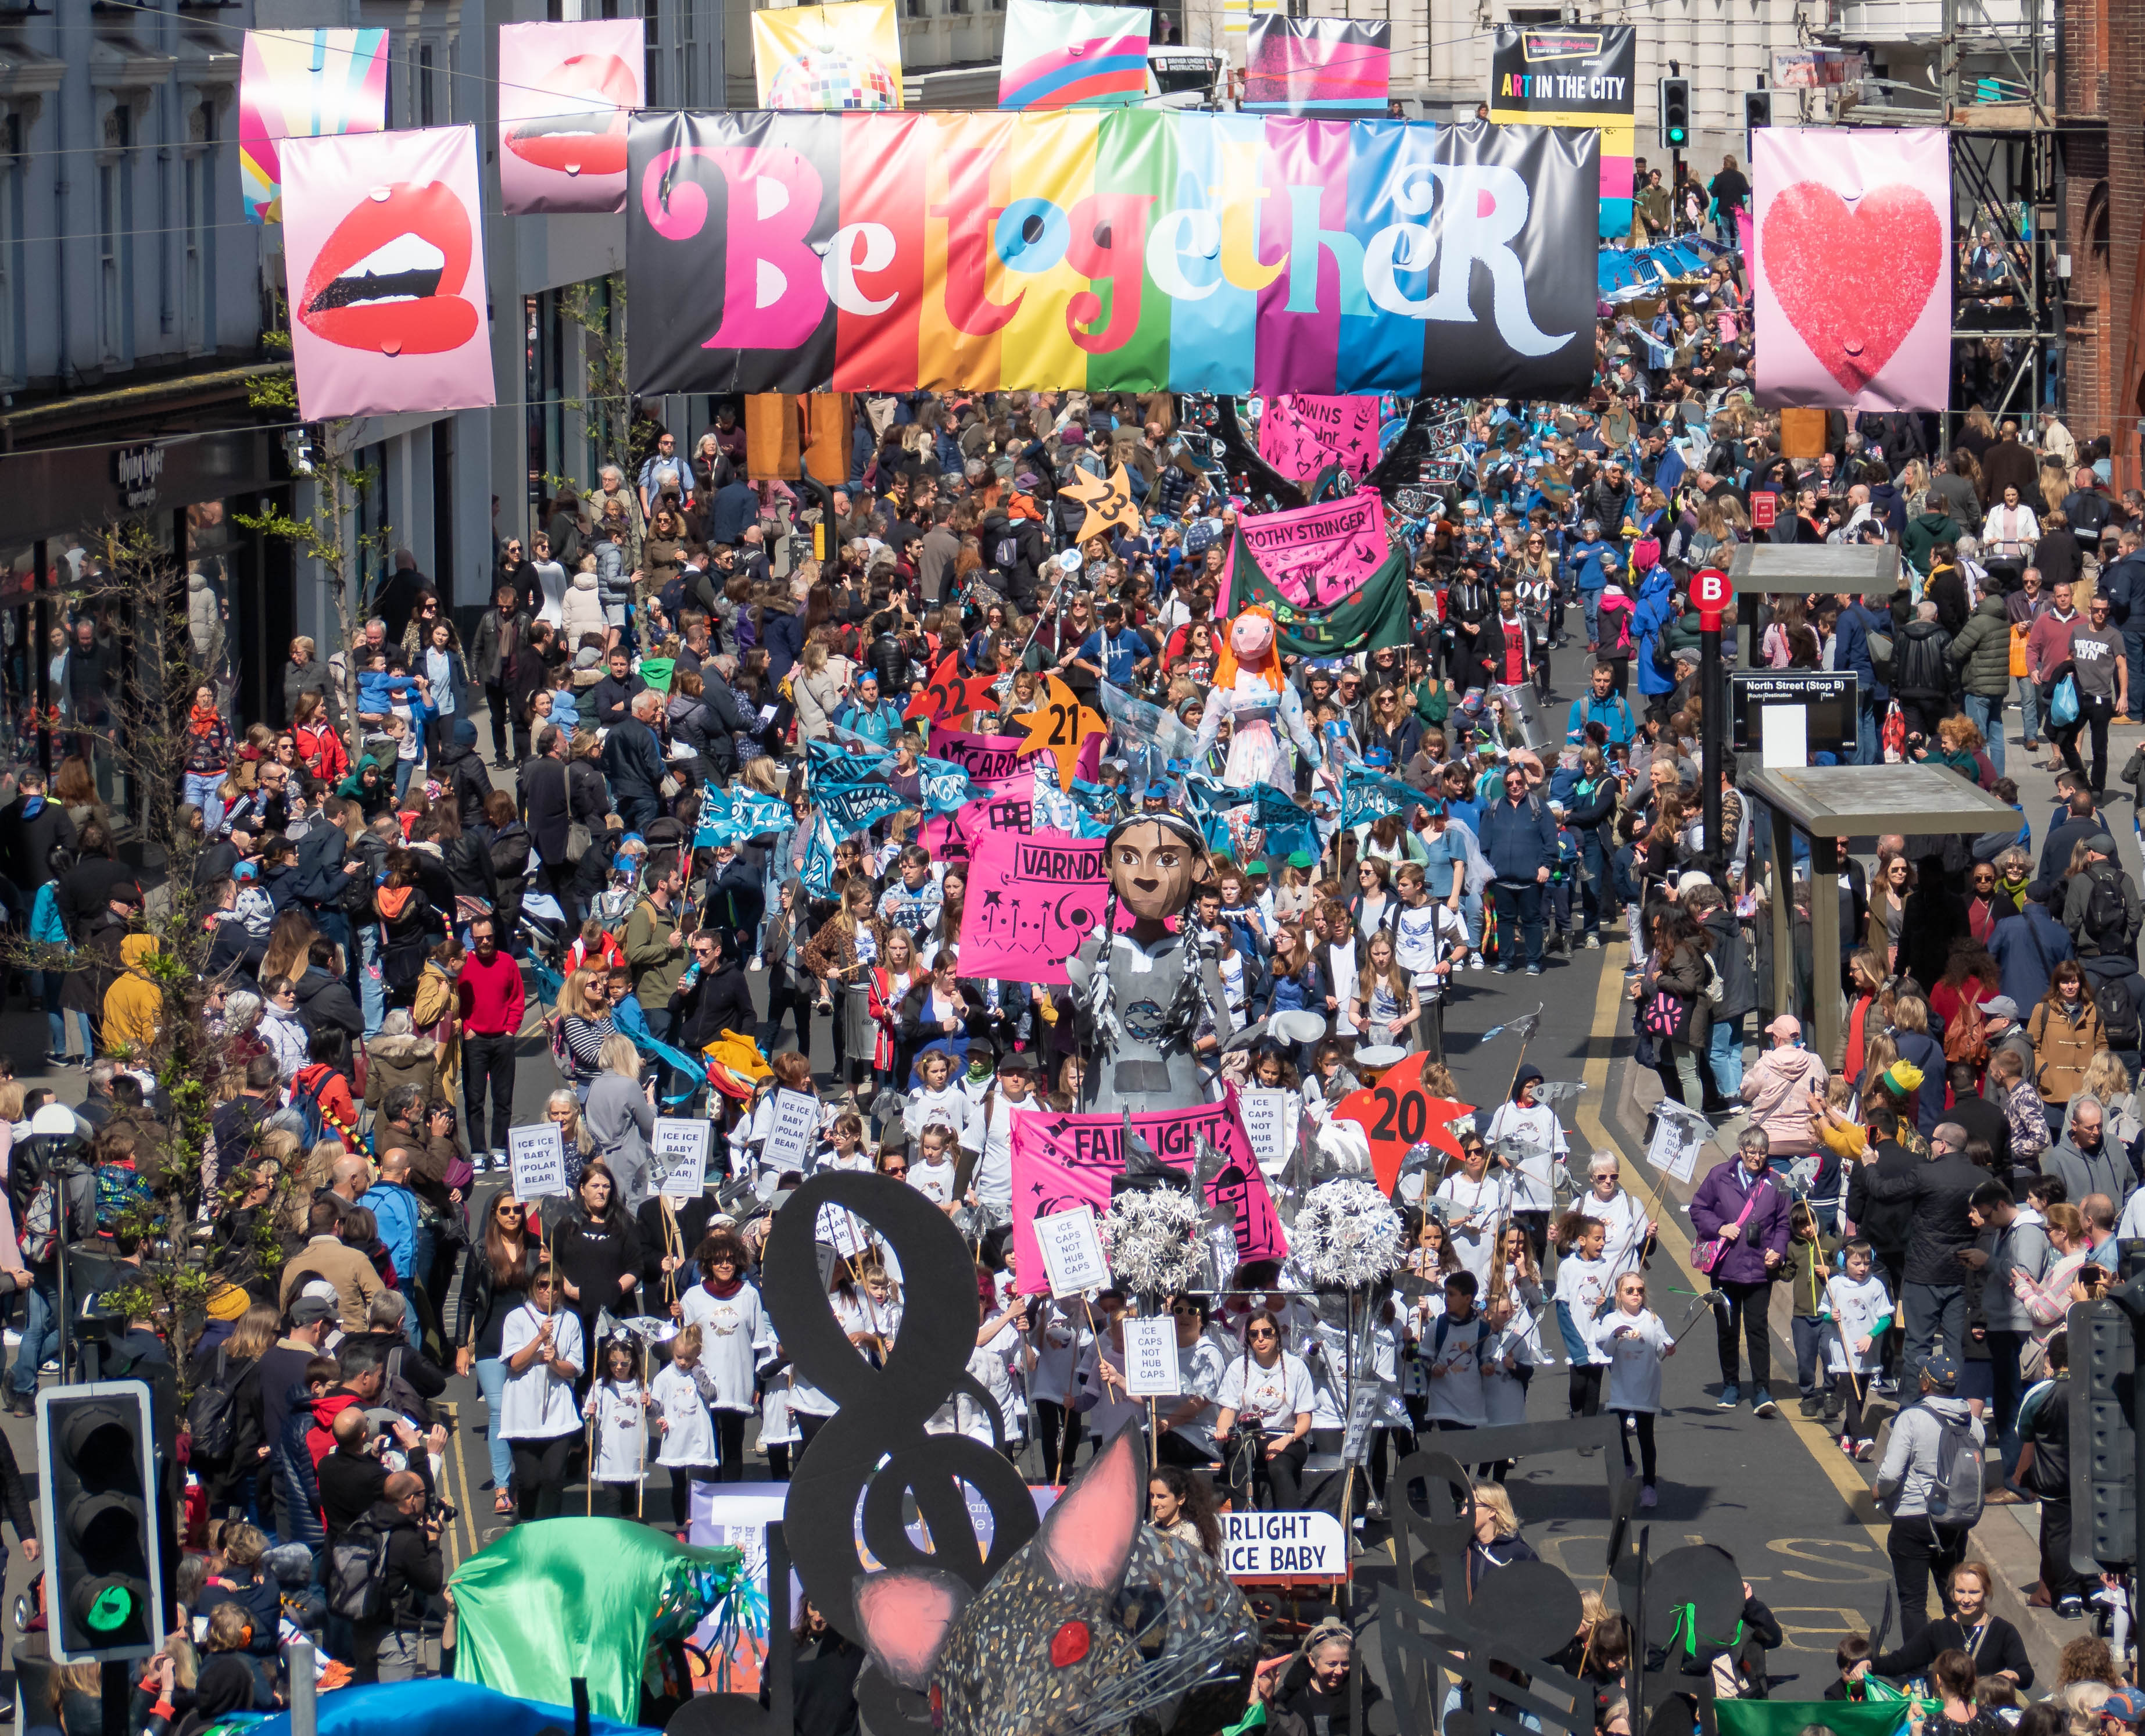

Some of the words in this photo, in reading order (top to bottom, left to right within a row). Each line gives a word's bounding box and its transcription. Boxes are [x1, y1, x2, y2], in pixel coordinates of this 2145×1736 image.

[1159, 60, 1165, 69] L
[1501, 73, 1532, 98] ART
[1536, 75, 1553, 98] IN
[1556, 76, 1587, 99] THE
[1591, 76, 1625, 100] CITY
[642, 146, 898, 350] Be
[1315, 426, 1340, 445] Jnr
[1087, 482, 1128, 521] 23
[1245, 526, 1294, 548] ROTHY
[1297, 511, 1366, 540] STRINGER
[1703, 577, 1722, 600] B
[1747, 681, 1773, 690] North
[1776, 681, 1804, 690] Street
[1806, 681, 1832, 692] (Stop
[1834, 681, 1845, 691] B)
[930, 678, 970, 720] 22
[1048, 703, 1079, 746] 21
[965, 749, 1044, 778] CARDEN
[1023, 849, 1107, 880] VARNDE
[782, 1102, 796, 1111] ICE
[797, 1105, 810, 1115] ICE
[1371, 1086, 1427, 1144] 20
[782, 1114, 803, 1126] BABY
[775, 1125, 804, 1139] (POLAR
[518, 1140, 535, 1148] ICE
[538, 1137, 554, 1146] ICE
[667, 1145, 693, 1153] BABY
[775, 1138, 798, 1151] BEAR)
[524, 1150, 550, 1159] BABY
[1664, 1147, 1681, 1161] DUM
[520, 1161, 556, 1173] (POLAR
[525, 1173, 554, 1183] BEAR)
[669, 1169, 692, 1179] EAR)
[817, 1207, 837, 1222] ABY
[1058, 1221, 1073, 1232] ICE
[827, 1230, 849, 1244] EAR)
[1055, 1231, 1081, 1244] CAPS
[1061, 1241, 1080, 1254] NOT
[1064, 1252, 1084, 1264] HUB
[1065, 1262, 1090, 1275] CAPS
[1138, 1337, 1162, 1346] CAPS
[1142, 1348, 1160, 1356] NOT
[1140, 1370, 1165, 1379] CAPS
[744, 1526, 755, 1570] Brighto
[1225, 1546, 1259, 1571] ICE
[1270, 1545, 1326, 1571] BABY
